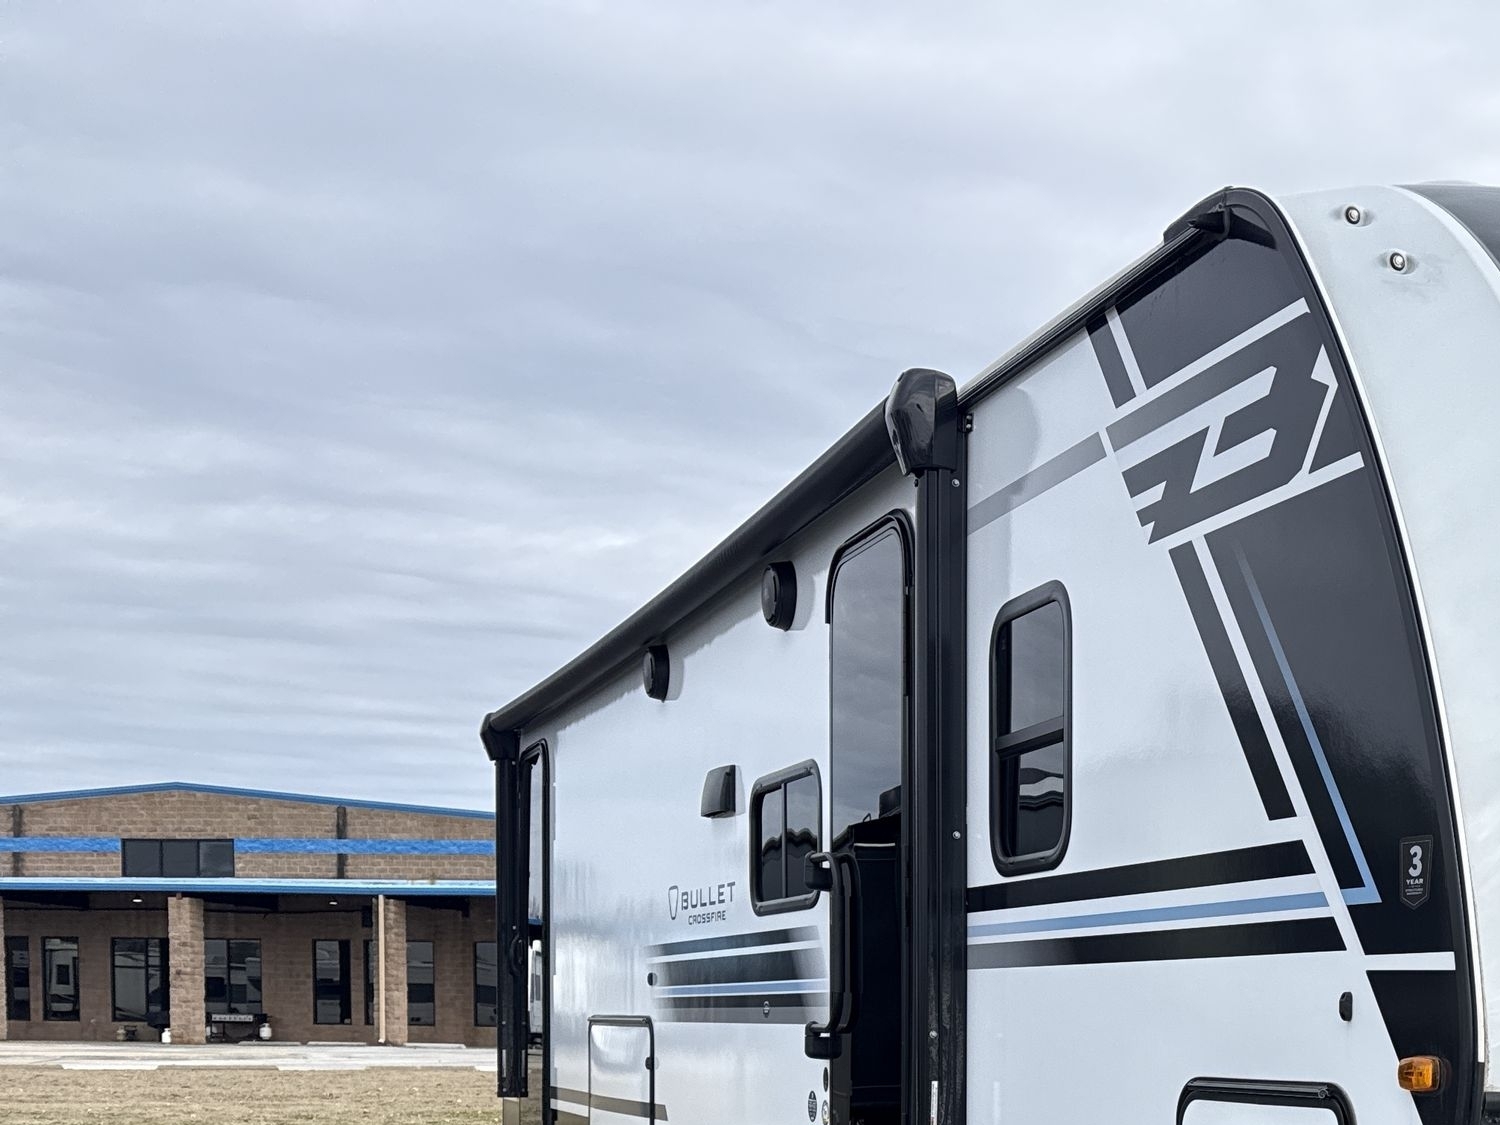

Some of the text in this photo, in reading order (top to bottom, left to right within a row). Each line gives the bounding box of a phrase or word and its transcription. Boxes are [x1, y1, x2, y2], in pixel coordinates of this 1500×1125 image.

[1408, 845, 1423, 877] 3
[681, 881, 736, 911] BULLET
[688, 910, 726, 925] CROSSFIRE
